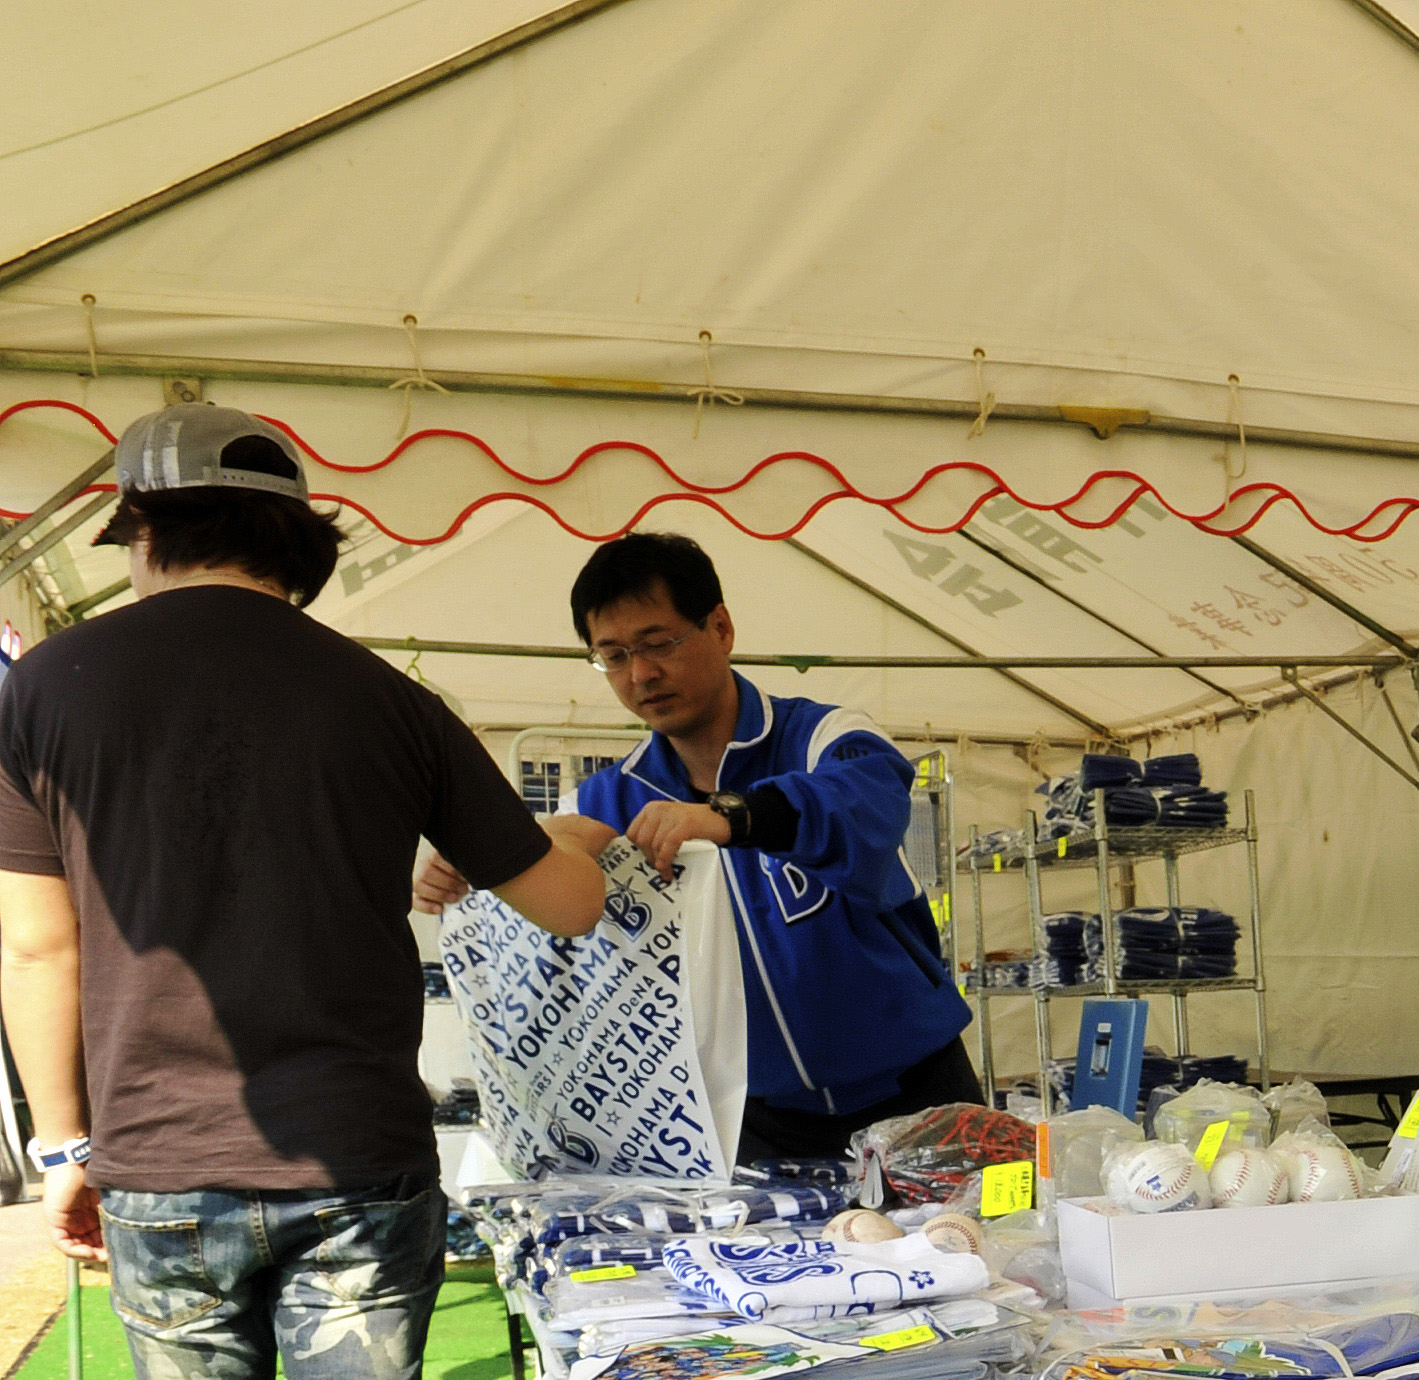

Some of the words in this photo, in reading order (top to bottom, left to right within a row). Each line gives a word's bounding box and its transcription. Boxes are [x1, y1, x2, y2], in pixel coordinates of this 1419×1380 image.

[506, 936, 619, 1071] YOKOHAMA
[557, 1018, 622, 1101] YOKOHAMA
[618, 974, 656, 1017] DeNA
[559, 956, 638, 1050] YOKOHAMA
[570, 985, 678, 1122] BAYSTARS
